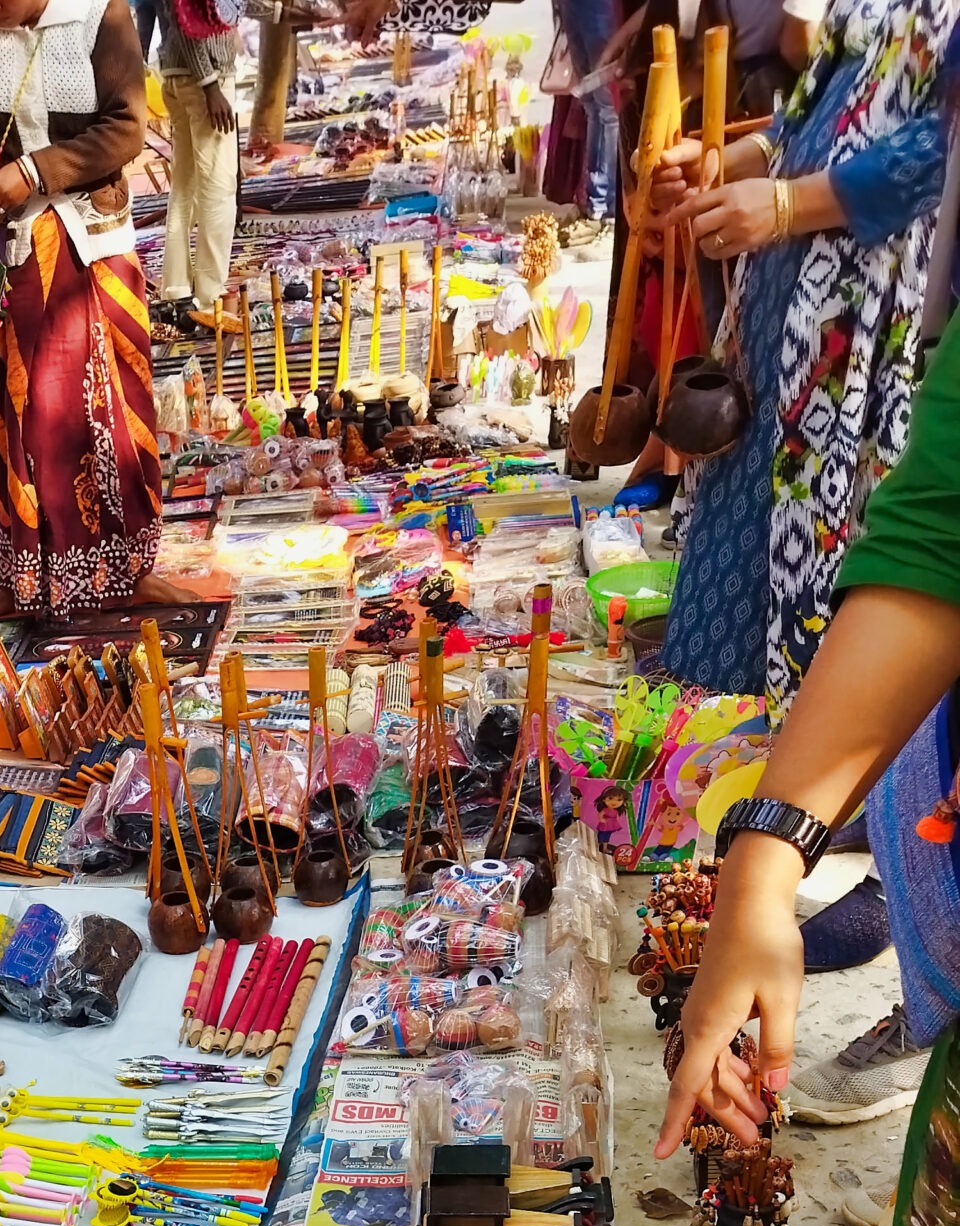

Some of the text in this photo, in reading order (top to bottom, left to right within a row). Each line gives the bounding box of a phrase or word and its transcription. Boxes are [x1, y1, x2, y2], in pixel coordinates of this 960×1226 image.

[619, 848, 632, 856] 24
[341, 1105, 397, 1119] MDS
[323, 1174, 404, 1184] EXCELLENCE
